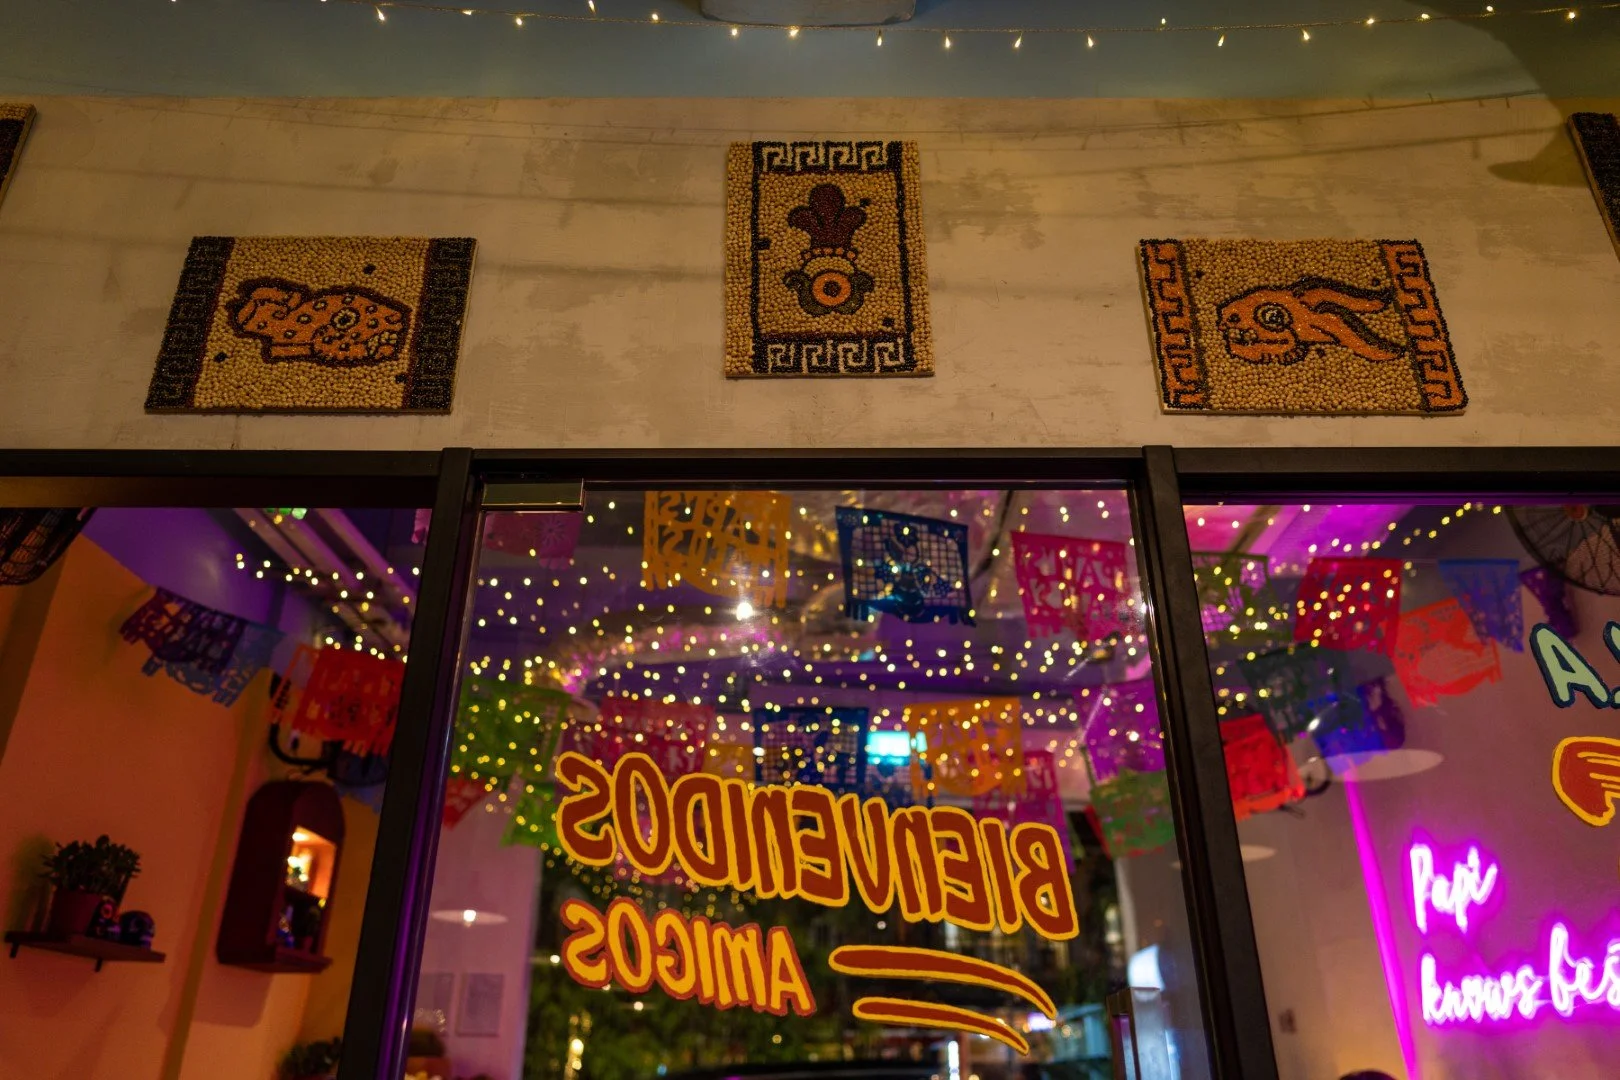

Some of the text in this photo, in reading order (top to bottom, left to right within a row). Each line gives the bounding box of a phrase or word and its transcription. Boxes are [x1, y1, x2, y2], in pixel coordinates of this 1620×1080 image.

[1410, 844, 1497, 934] Papi
[1421, 922, 1620, 1025] knows bes
